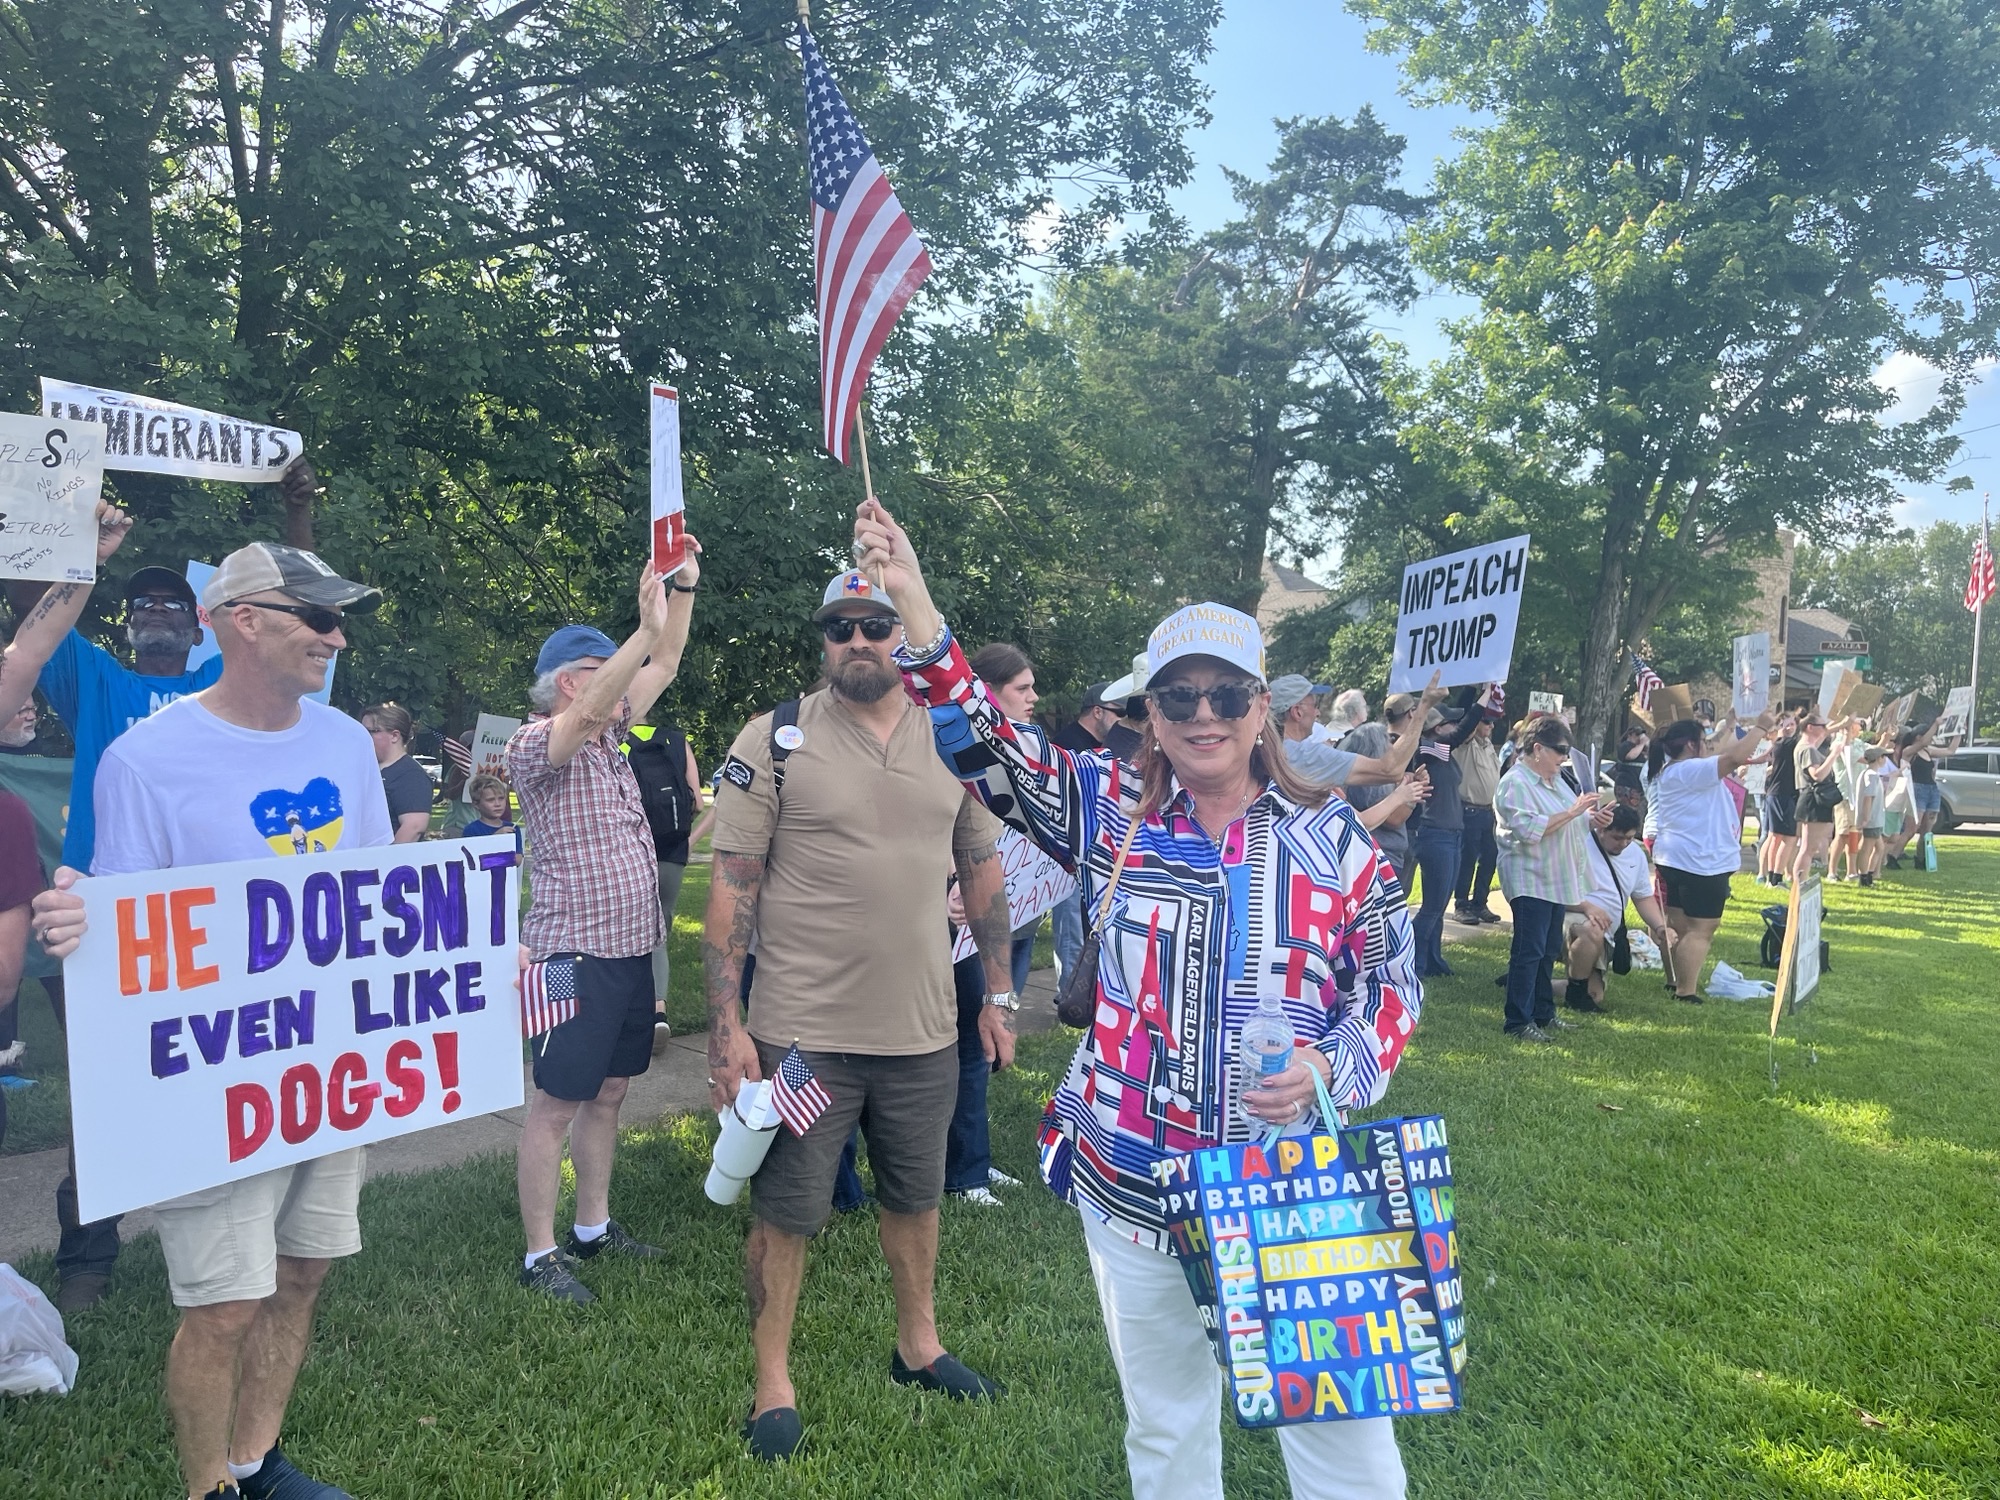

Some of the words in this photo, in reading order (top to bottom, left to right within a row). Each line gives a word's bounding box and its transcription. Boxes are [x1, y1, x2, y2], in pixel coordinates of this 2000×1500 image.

[44, 475, 86, 502] KINGS
[1403, 547, 1525, 616] IMPEACH
[1151, 613, 1185, 647] MAKE
[1186, 606, 1252, 633] AMERICA
[1156, 627, 1197, 660] GREAT
[1200, 626, 1245, 651] AGAIN
[1408, 612, 1497, 669] TRUMP
[116, 886, 220, 997] HE
[245, 845, 516, 974] DOESN'T
[1184, 902, 1205, 942] KARL
[150, 989, 316, 1079] EVEN
[352, 961, 487, 1034] LIKE
[1183, 943, 1202, 1042] LAGERFELD
[1181, 1042, 1199, 1093] PARIS
[225, 1031, 462, 1163] DOGS!
[1200, 1129, 1370, 1185] HAPPY
[1372, 1128, 1415, 1229] HOORAY
[1205, 1168, 1379, 1211] BIRTHDAY
[1261, 1201, 1366, 1239] HAPPY
[1266, 1238, 1403, 1278] BIRTHDAY
[1210, 1210, 1279, 1422] SURPRISE
[1264, 1277, 1390, 1312] HAPPY
[1269, 1309, 1404, 1365] BIRTH
[1393, 1273, 1454, 1410] HAPPY
[1277, 1362, 1414, 1419] DAY!!!
